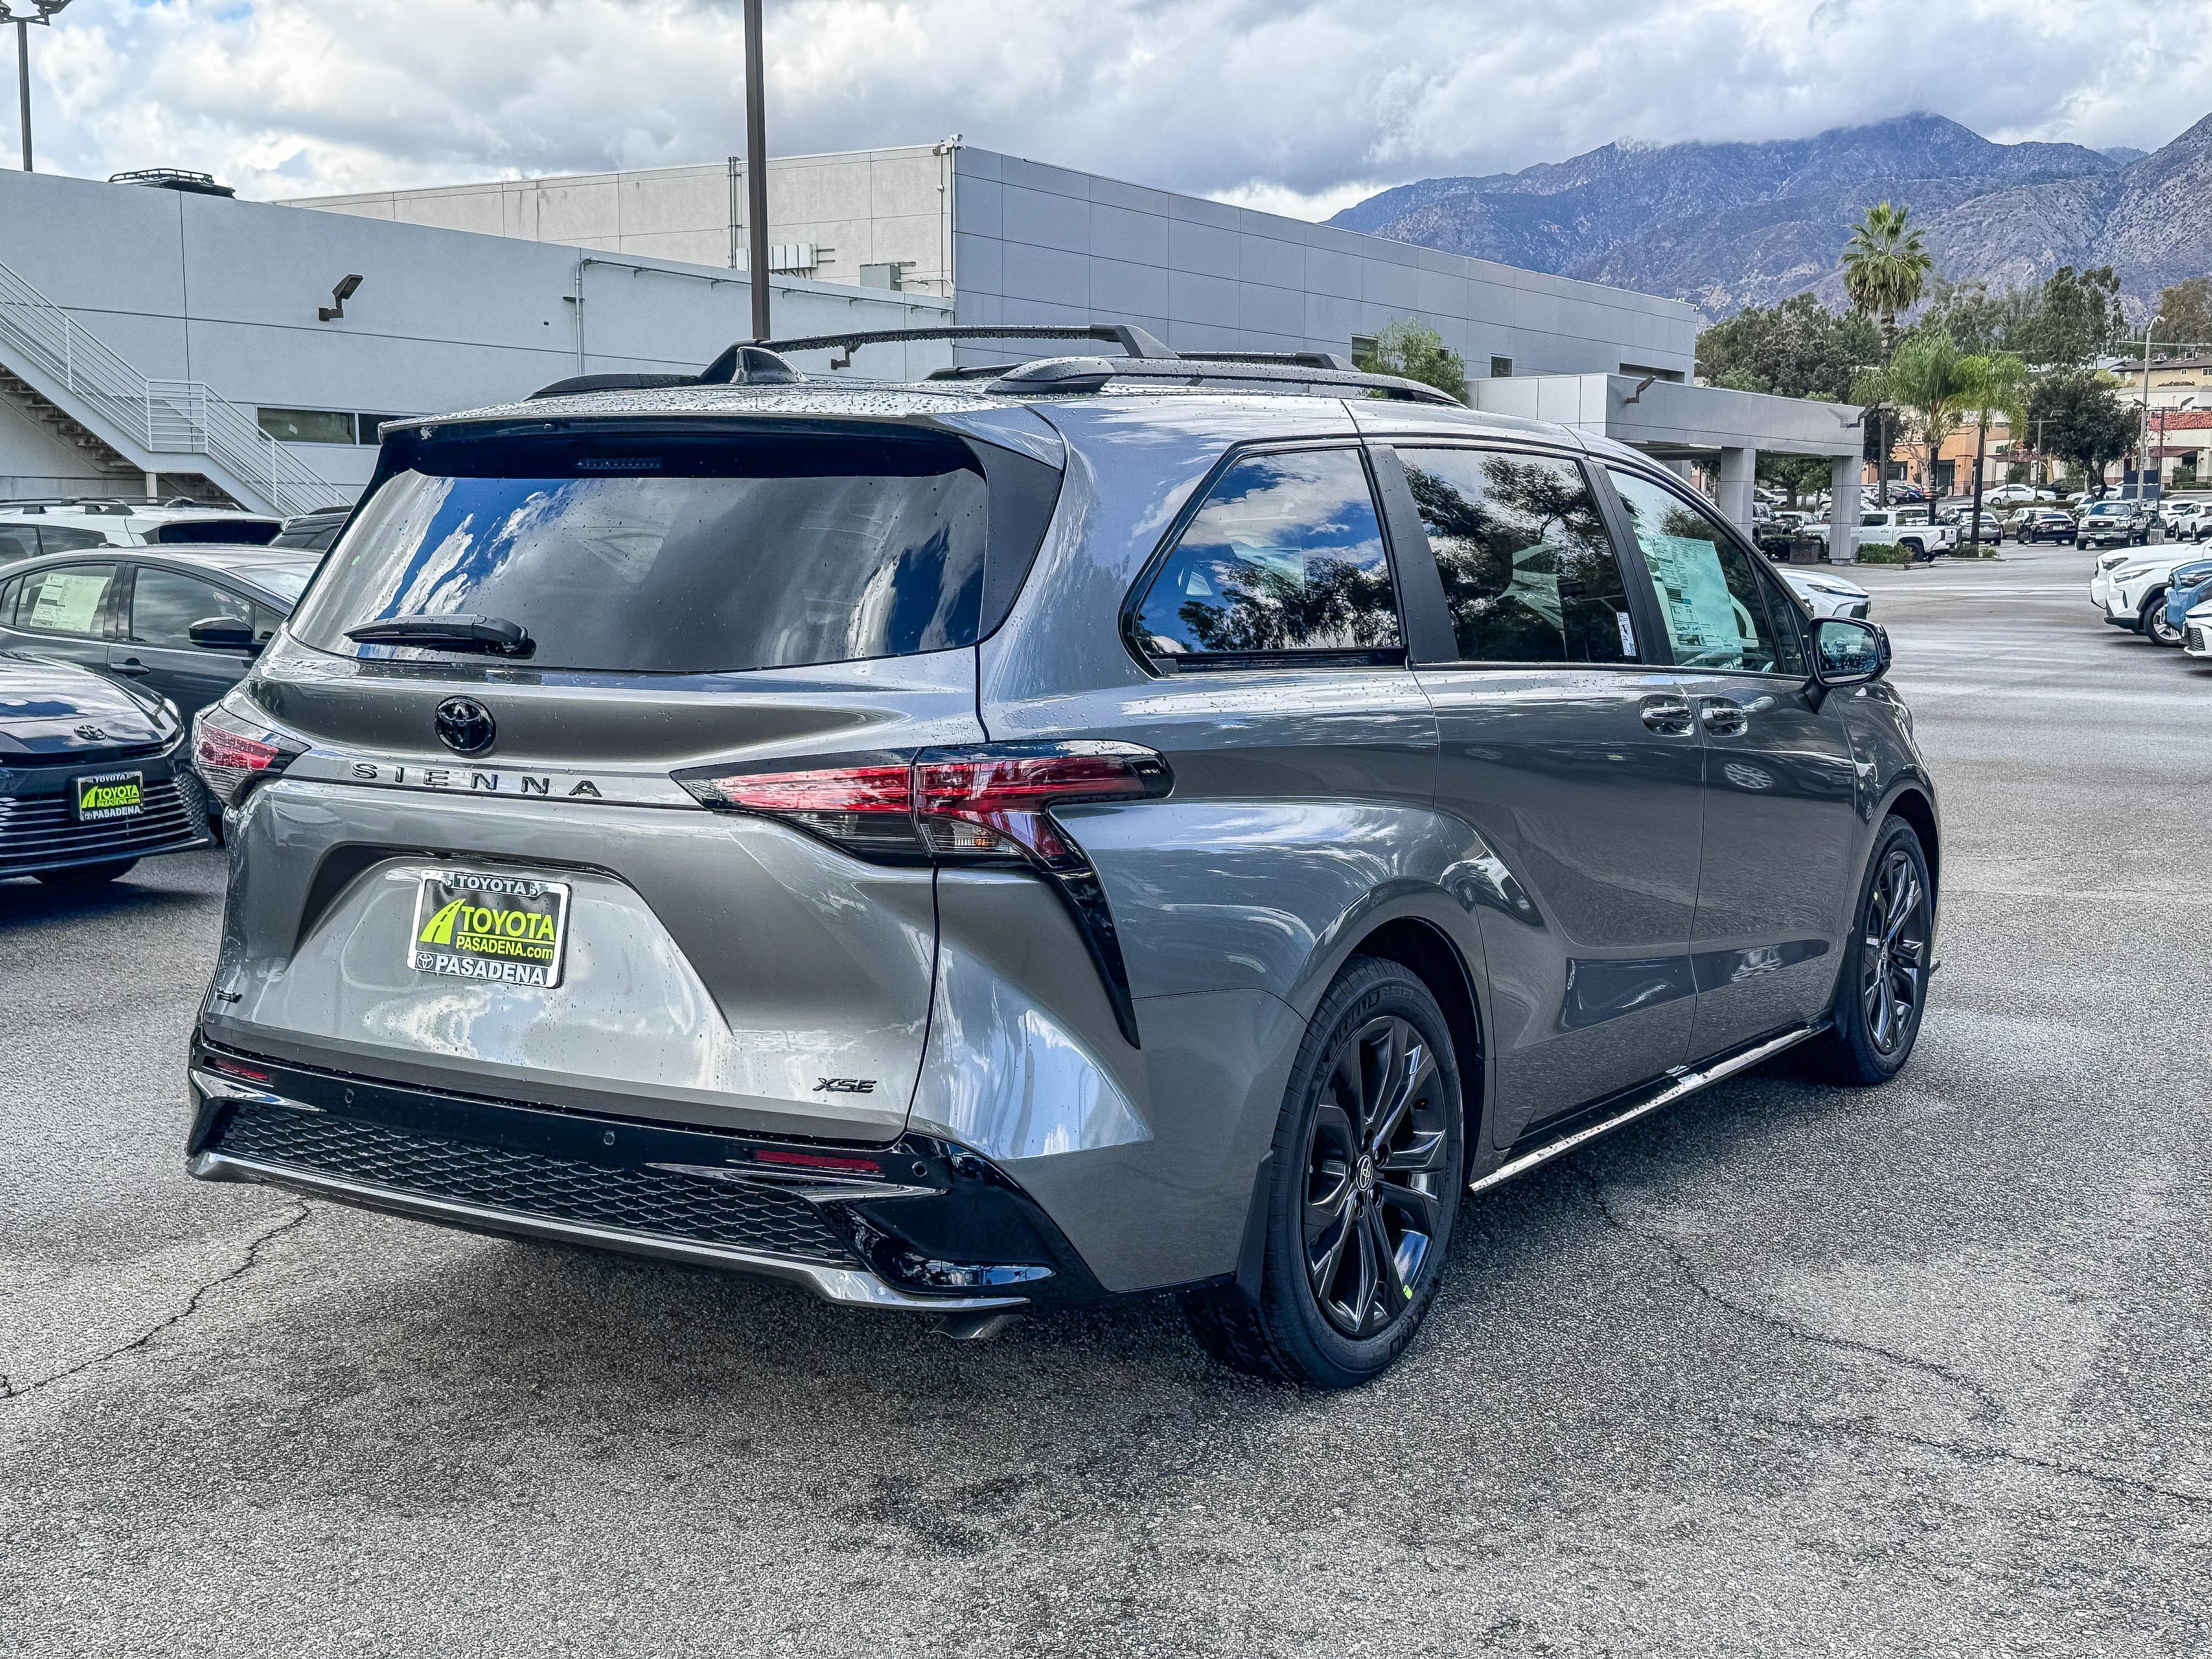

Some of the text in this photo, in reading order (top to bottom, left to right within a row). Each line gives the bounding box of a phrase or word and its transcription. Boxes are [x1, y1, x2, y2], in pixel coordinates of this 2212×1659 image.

[352, 763, 602, 797] SIENNA
[97, 785, 139, 800] TOYOTA
[457, 876, 527, 895] TOYOTA
[460, 905, 555, 940] TOYOTA
[455, 936, 554, 960] PASADENA.com
[435, 955, 546, 985] PASADENA
[812, 1077, 877, 1093] XSE
